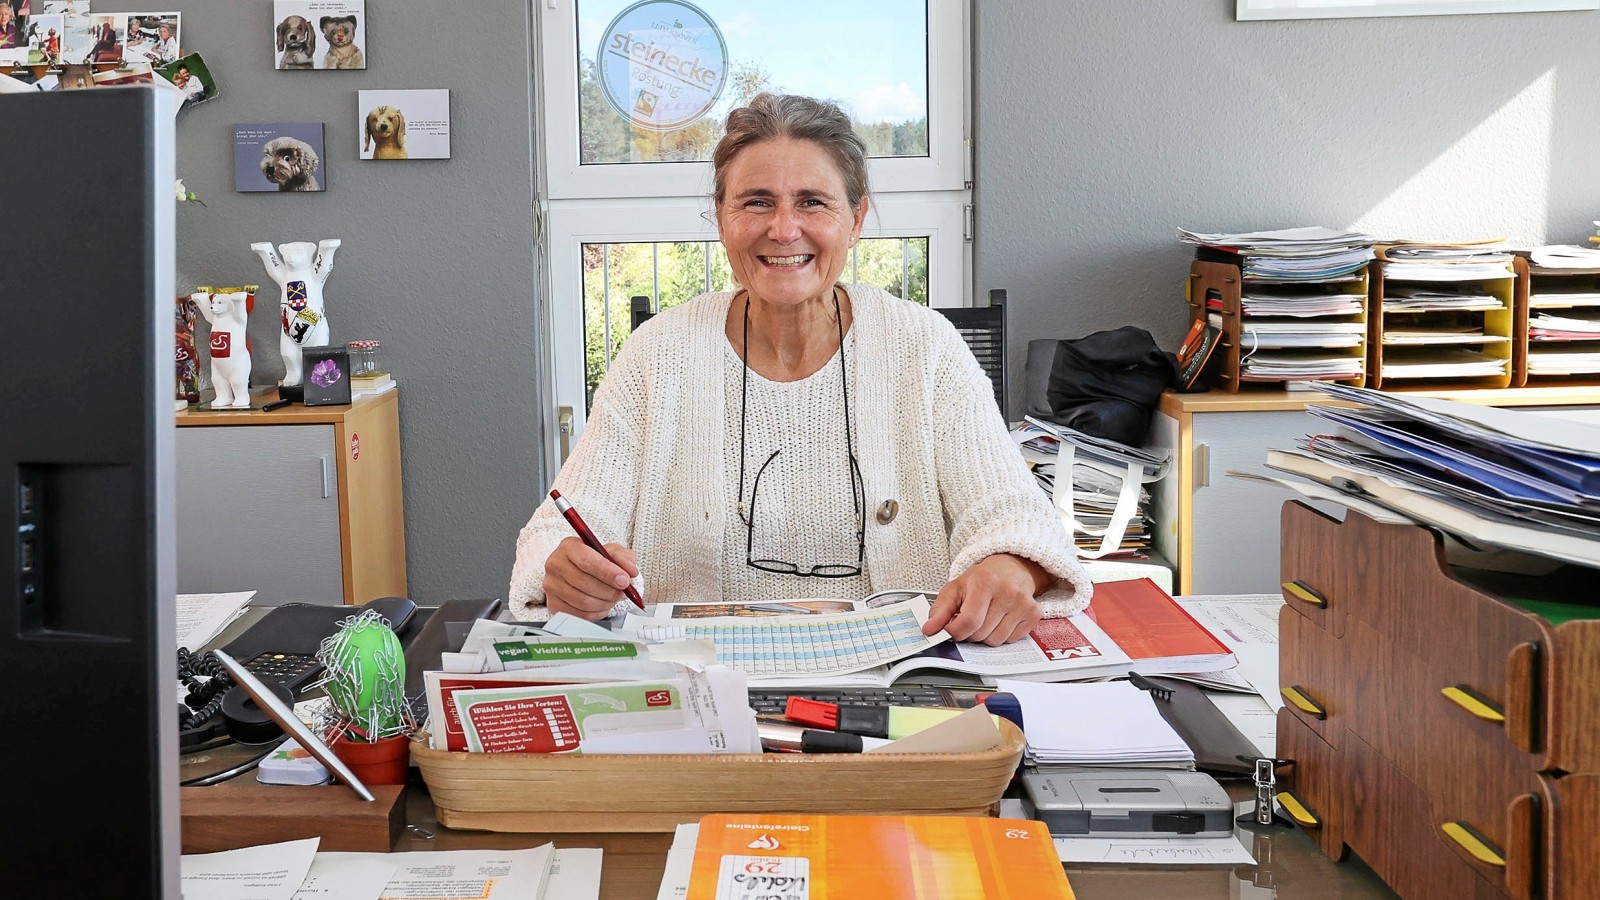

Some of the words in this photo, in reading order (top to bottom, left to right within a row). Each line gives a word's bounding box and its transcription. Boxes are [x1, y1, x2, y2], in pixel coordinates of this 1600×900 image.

[611, 32, 717, 87] steinecke
[631, 67, 681, 99] Röstung
[498, 647, 529, 656] vegan
[534, 646, 572, 654] Vielfalt
[574, 645, 626, 655] genießen!
[473, 705, 504, 714] Wählen
[725, 823, 810, 832] Clairefontaine
[745, 862, 783, 874] 29
